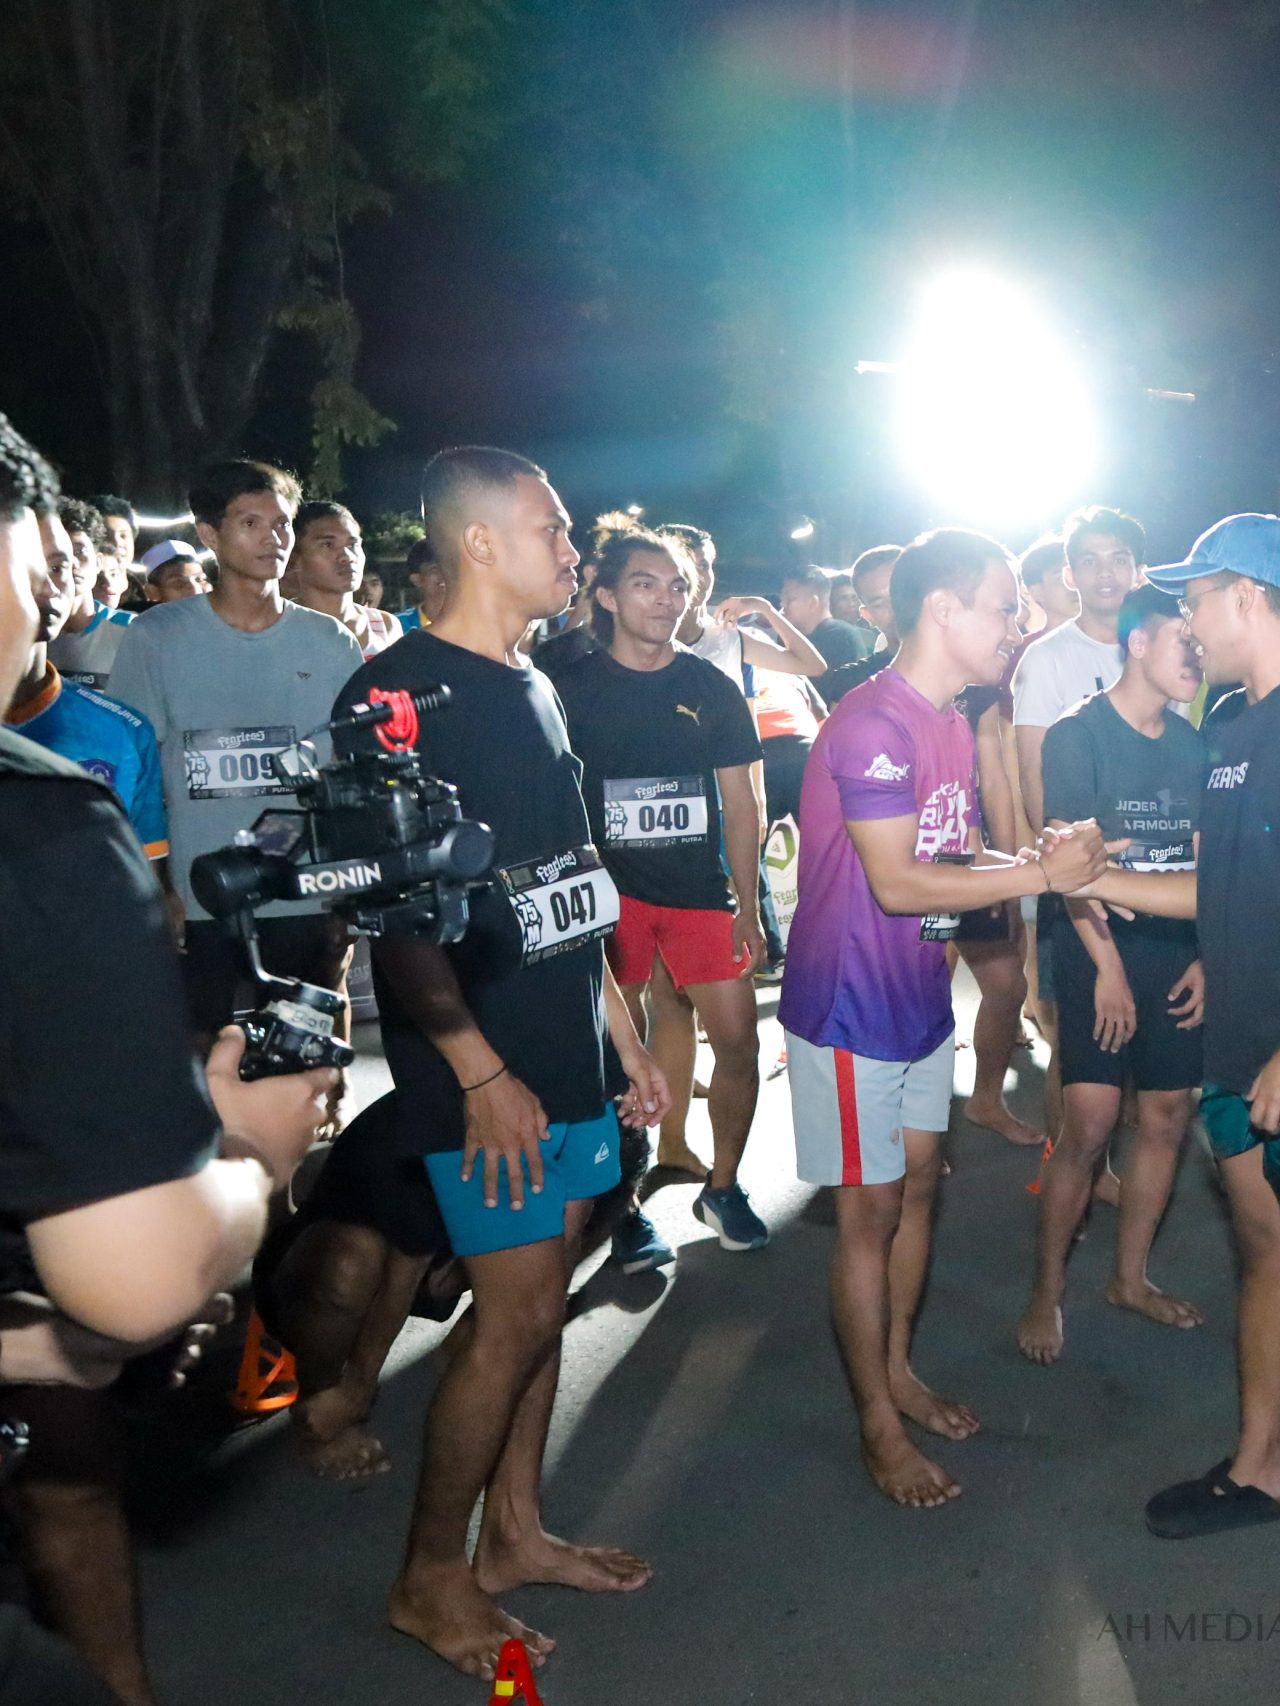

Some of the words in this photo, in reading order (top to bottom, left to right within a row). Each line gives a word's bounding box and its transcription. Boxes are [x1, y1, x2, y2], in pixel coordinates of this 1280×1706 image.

[219, 753, 278, 782] 009
[639, 803, 690, 833] 040
[297, 861, 382, 895] RONIN
[517, 903, 539, 925] 75
[549, 881, 596, 932] 047
